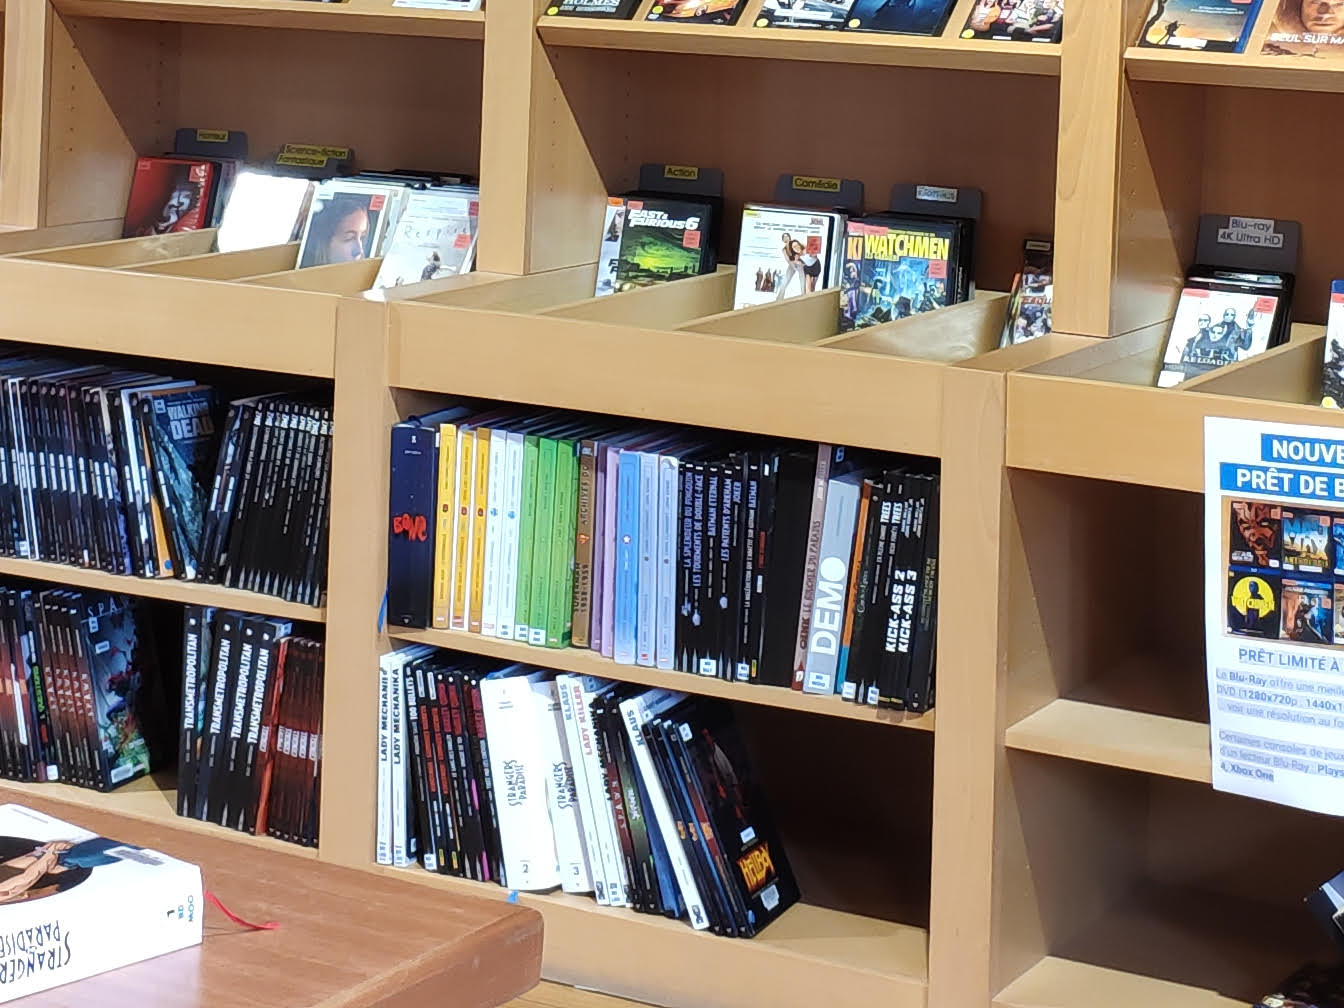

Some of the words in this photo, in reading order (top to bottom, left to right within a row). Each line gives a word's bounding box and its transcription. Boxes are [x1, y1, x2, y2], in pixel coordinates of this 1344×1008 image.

[1270, 33, 1302, 43] SEUL
[1304, 34, 1329, 45] SUR
[666, 167, 696, 177] Action
[794, 178, 838, 190] Comédie
[629, 219, 685, 230] FURIOUS
[1219, 231, 1234, 241] 4K
[1236, 233, 1261, 244] Ultra
[1263, 235, 1280, 245] HD
[1231, 220, 1271, 231] Blu-ray
[864, 234, 949, 260] WATCHMEN
[733, 482, 741, 503] JOKER
[1236, 467, 1293, 493] PRÊT
[1299, 476, 1329, 496] DE
[580, 482, 588, 524] ARCHIVES
[892, 503, 902, 523] TREES
[708, 507, 717, 536] BATMAN
[811, 556, 847, 656] DEMO
[885, 583, 903, 652] KICK-ASS
[895, 569, 905, 581] 2
[898, 583, 915, 653] KICK-ASS
[907, 569, 917, 581] 3
[1239, 647, 1274, 665] PRÊT
[1279, 655, 1326, 671] LIMITÉ
[1330, 658, 1340, 672] À
[184, 633, 197, 729] TRANSMETROPOLITAN
[210, 638, 231, 734] TRANSMETROPOLITAN
[231, 643, 253, 739] TRANSMETROPOLITAN
[407, 666, 415, 703] BULLETS
[1229, 671, 1267, 688] Blu-Ray
[1296, 682, 1315, 691] une
[247, 648, 269, 744] TRANSMETROPOLITAN
[392, 668, 400, 734] MECHANIKA
[559, 684, 572, 721] KLAUS
[573, 685, 585, 726] KILLER
[410, 704, 418, 720] 100
[1266, 709, 1316, 724] résolution
[624, 709, 644, 746] KLAUS
[393, 737, 401, 765] LADY
[581, 729, 593, 756] LADY
[1230, 764, 1254, 777] Xbox
[1256, 768, 1274, 781] One
[522, 863, 528, 874] 2
